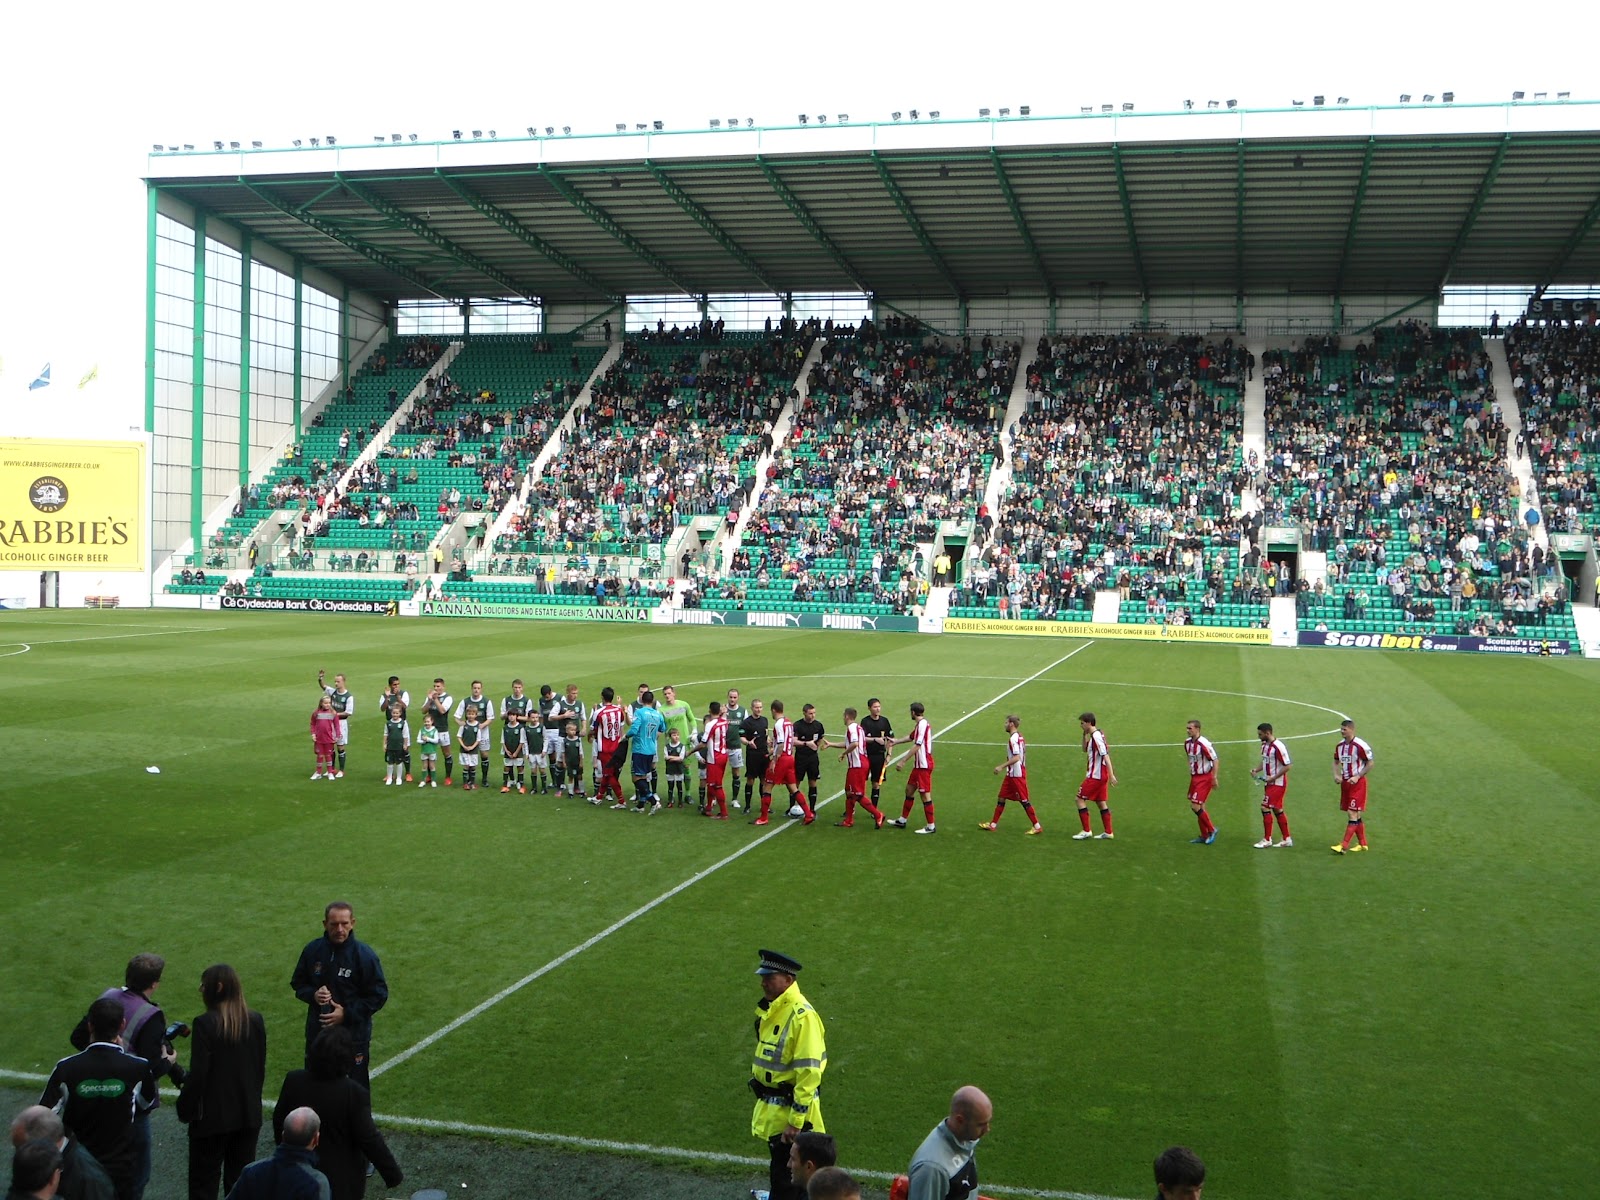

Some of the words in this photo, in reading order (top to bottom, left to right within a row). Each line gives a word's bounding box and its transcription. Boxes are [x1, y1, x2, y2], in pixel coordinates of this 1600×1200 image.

[3, 460, 100, 469] WWW.CRABBIESGINGERBEER.CO.UK
[48, 554, 84, 562] GINGER
[87, 554, 109, 562] BEER
[237, 598, 284, 609] Clydesdale
[285, 600, 308, 609] Bank
[323, 601, 372, 612] Clydesdale
[435, 604, 482, 615] ANNAN
[483, 606, 519, 614] SOLICITORS
[535, 608, 557, 616] ESTATE
[559, 609, 584, 617] AGENTS
[585, 608, 634, 620] ANNAN
[944, 622, 986, 630] CRABBIE'S
[1051, 625, 1094, 634] CRABBIE'S
[1479, 645, 1527, 653] Bookmaking
[80, 1084, 121, 1093] Specsavers
